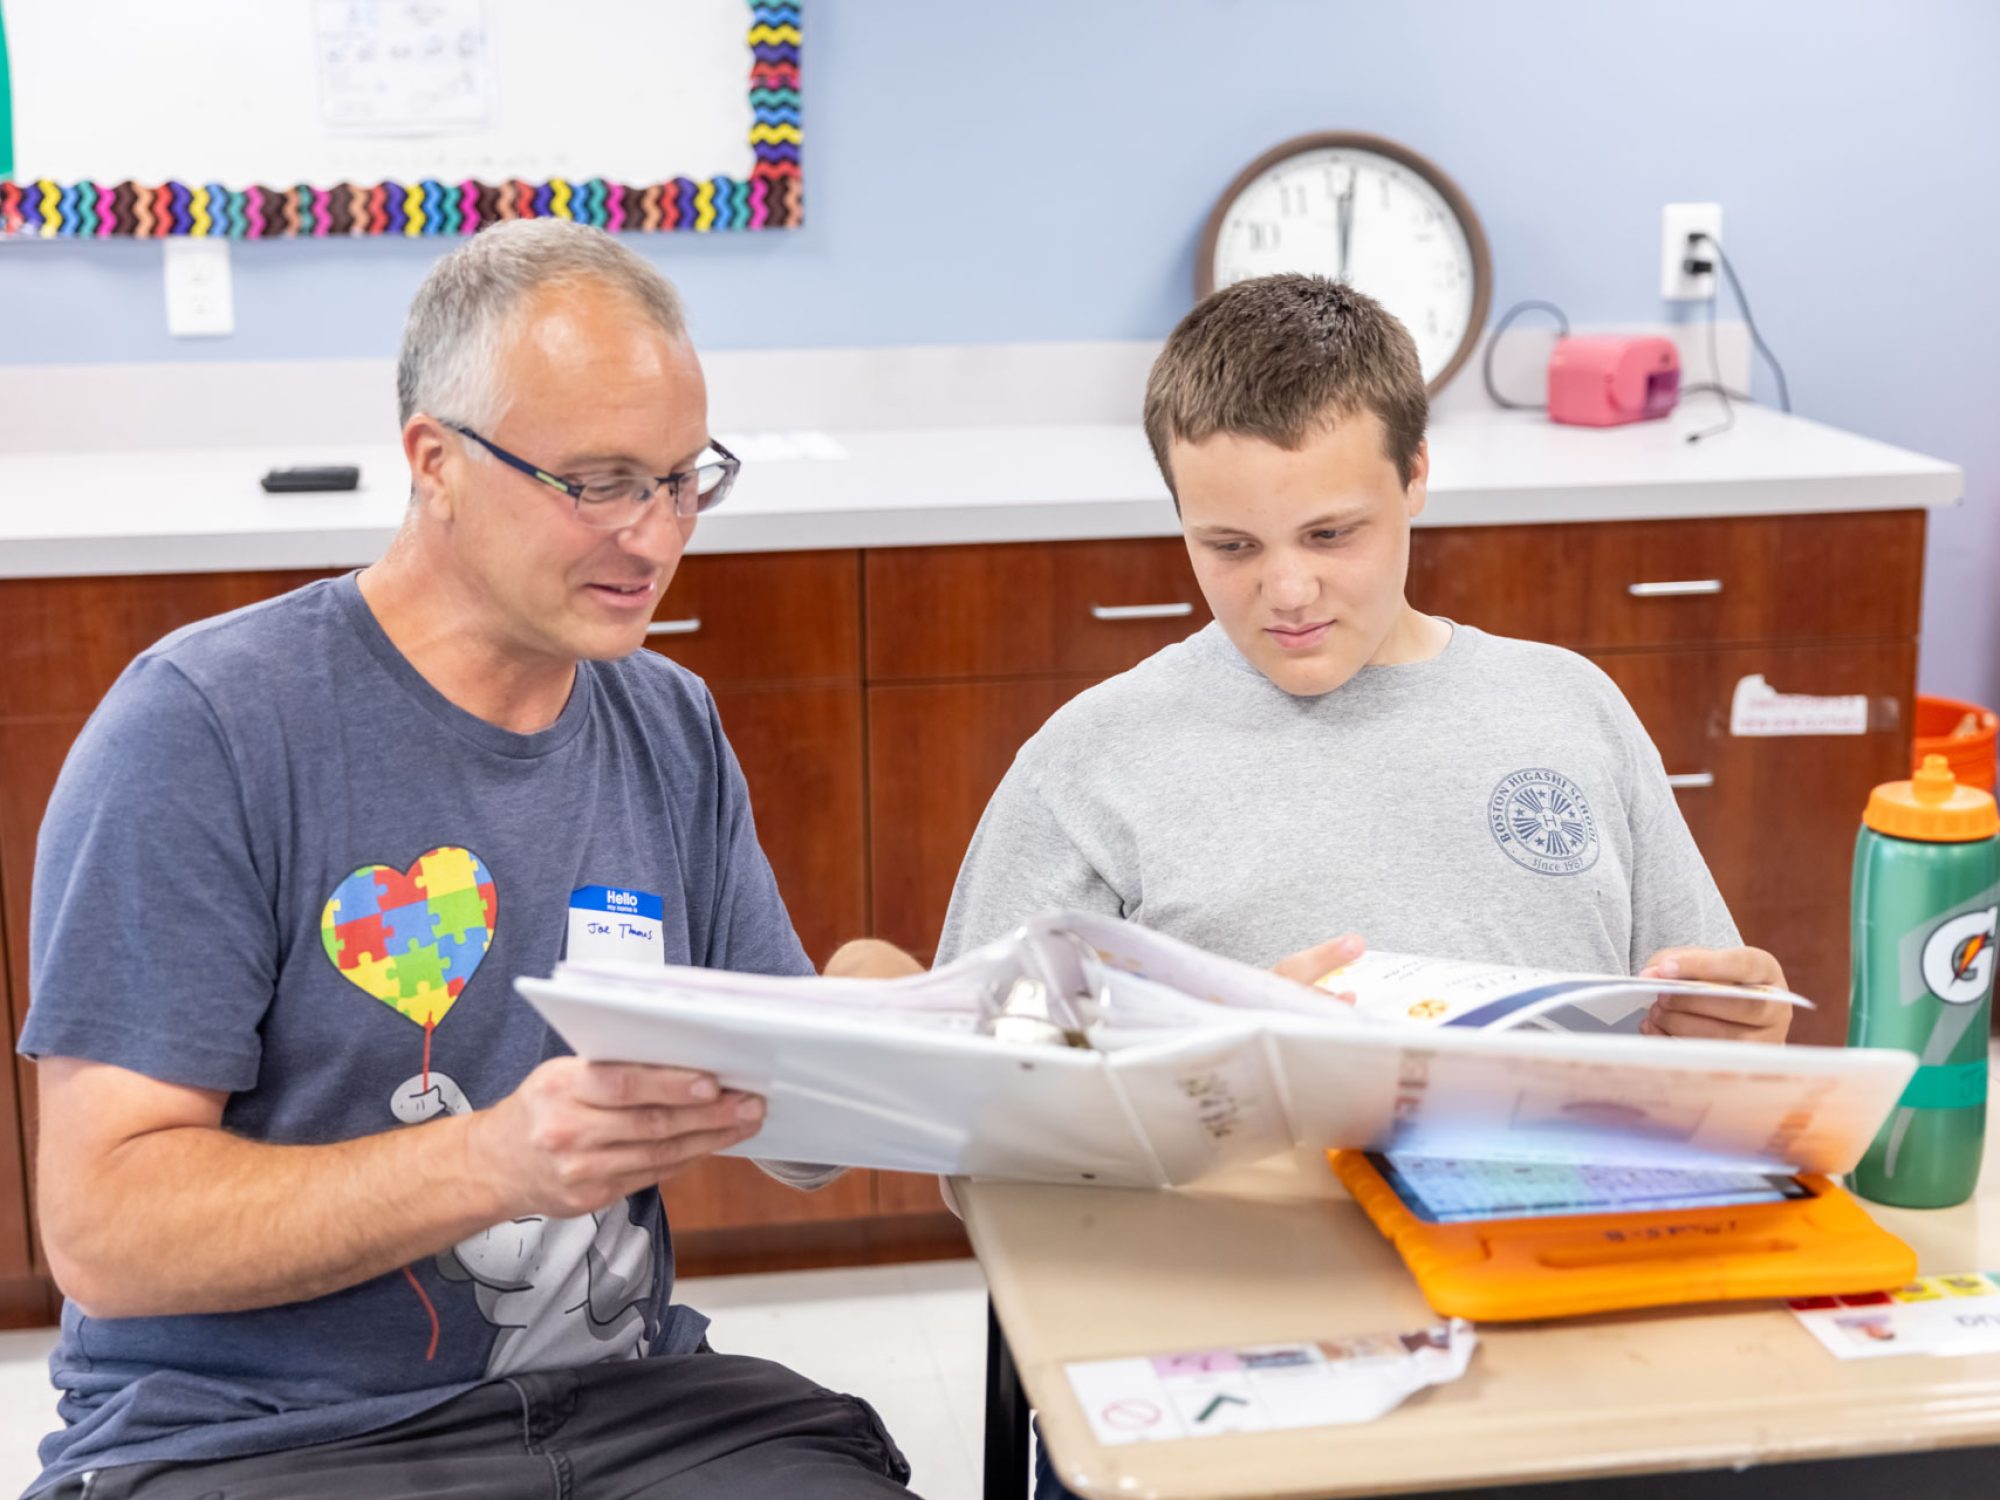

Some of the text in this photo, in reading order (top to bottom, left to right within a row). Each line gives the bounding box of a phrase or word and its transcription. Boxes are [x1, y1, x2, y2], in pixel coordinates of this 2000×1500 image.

[1280, 184, 1307, 216] 11
[1250, 223, 1281, 251] 10
[1492, 773, 1597, 844] BOSTON HIGASHI SCHOOL
[1532, 857, 1560, 872] since
[607, 890, 637, 906] Hello
[587, 923, 611, 935] Joe
[1920, 904, 1997, 1005] G
